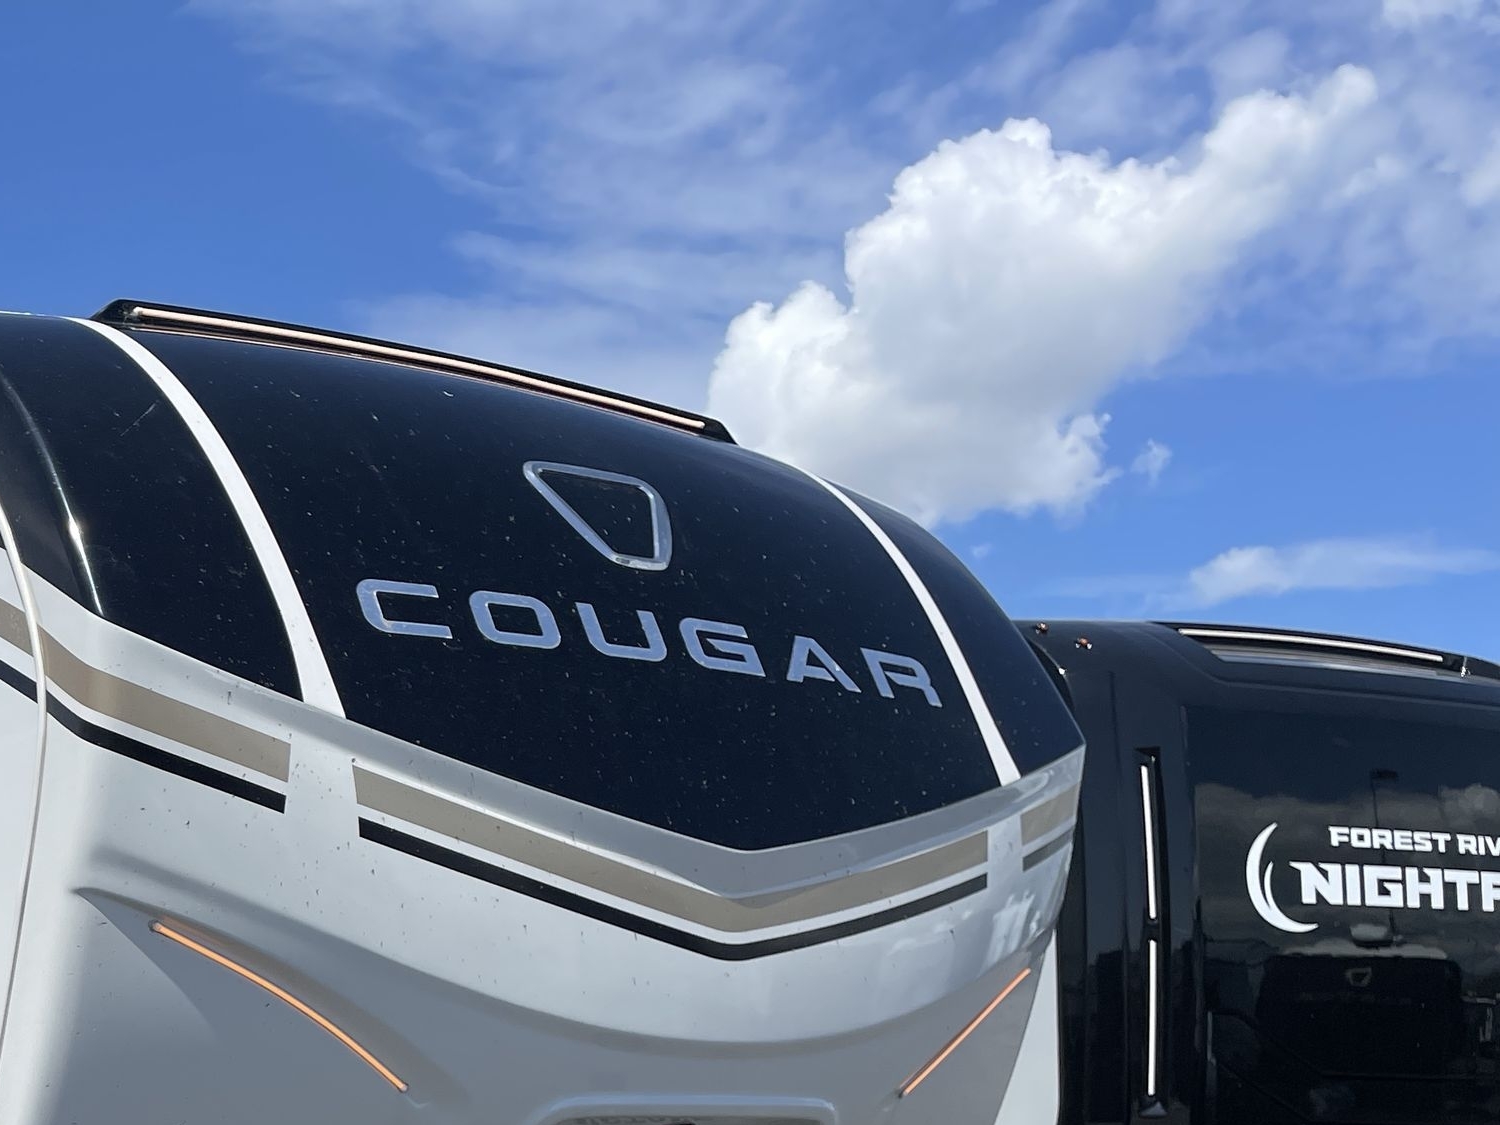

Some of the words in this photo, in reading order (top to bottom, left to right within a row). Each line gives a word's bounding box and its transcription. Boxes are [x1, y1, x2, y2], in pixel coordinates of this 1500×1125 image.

[355, 577, 943, 709] COUGAR
[1328, 825, 1452, 854] FOREST
[1456, 833, 1500, 857] RIV
